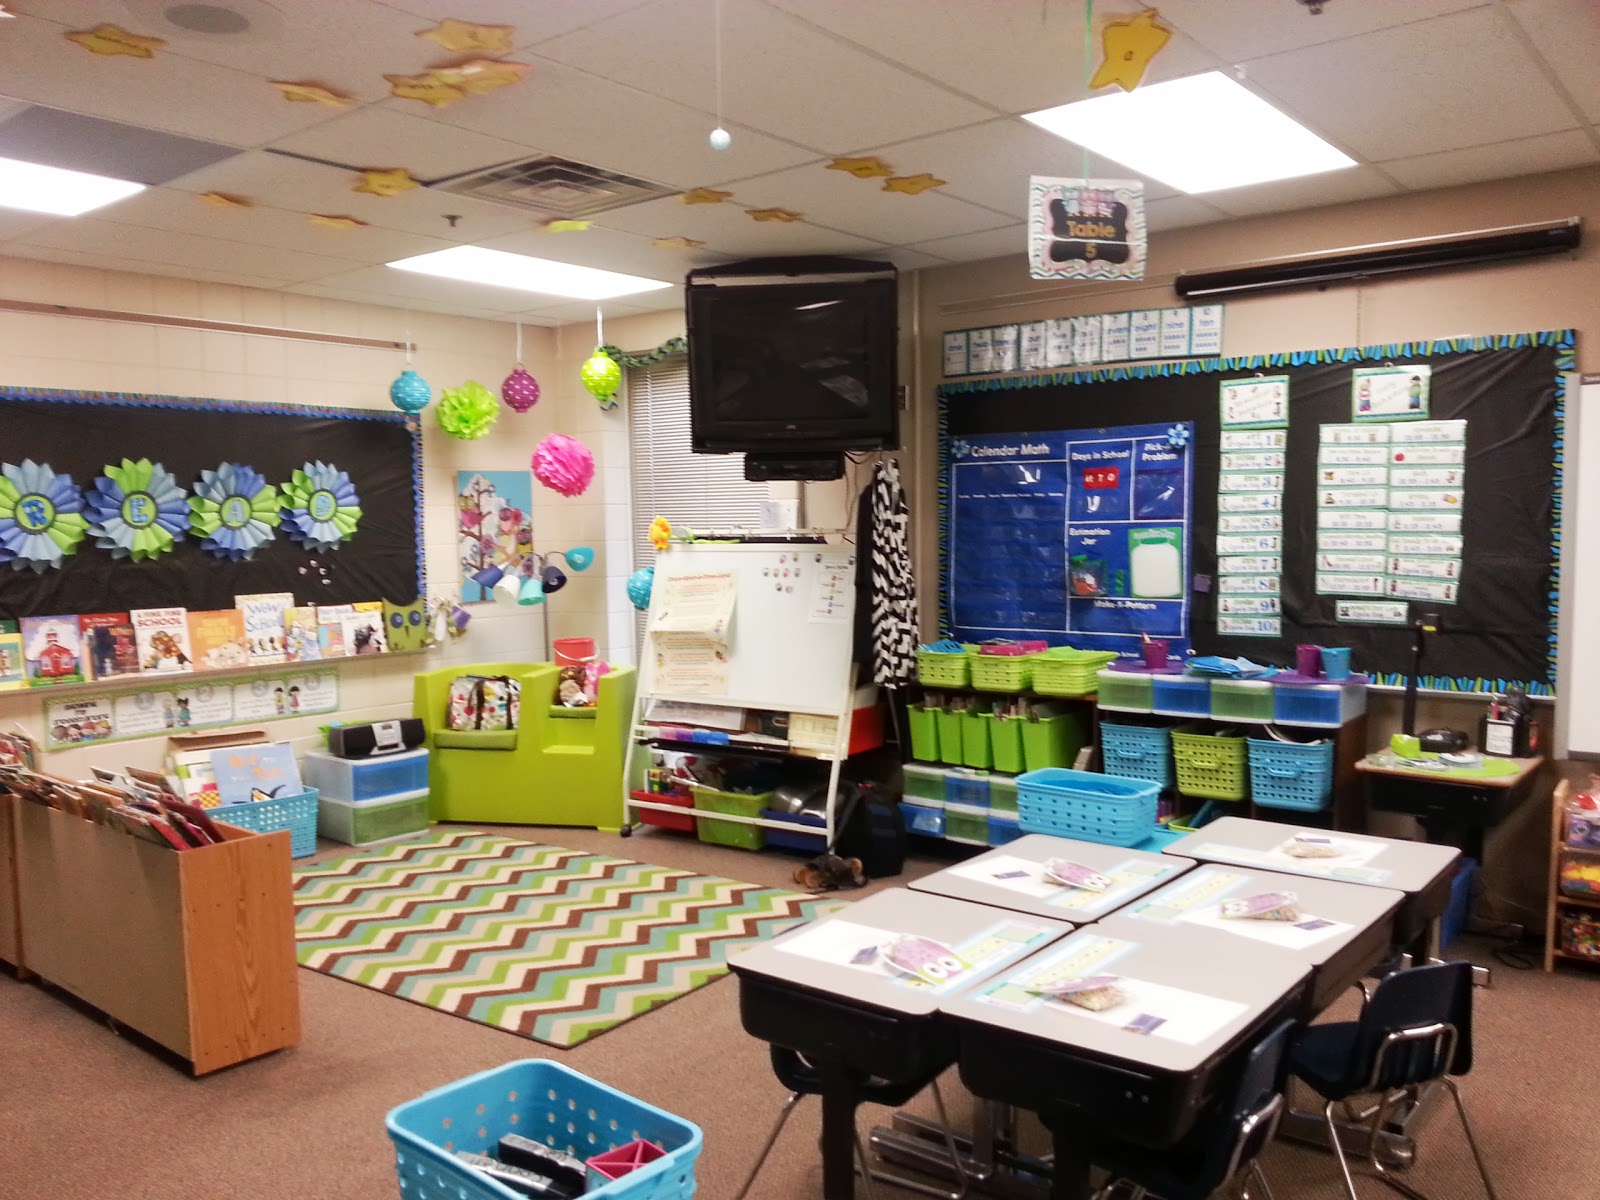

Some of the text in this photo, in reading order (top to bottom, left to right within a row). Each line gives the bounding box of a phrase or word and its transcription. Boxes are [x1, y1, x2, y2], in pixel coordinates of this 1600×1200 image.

[1066, 221, 1116, 238] Table
[1085, 242, 1097, 258] 5
[971, 443, 1050, 457] Calendar Math
[1071, 450, 1130, 461] Days in School
[1142, 452, 1178, 461] Problem
[22, 495, 331, 527] R E A D
[1069, 528, 1111, 536] Estimation
[1081, 537, 1097, 545] Jar
[137, 618, 183, 627] SCHOOL
[1257, 621, 1272, 631] 10
